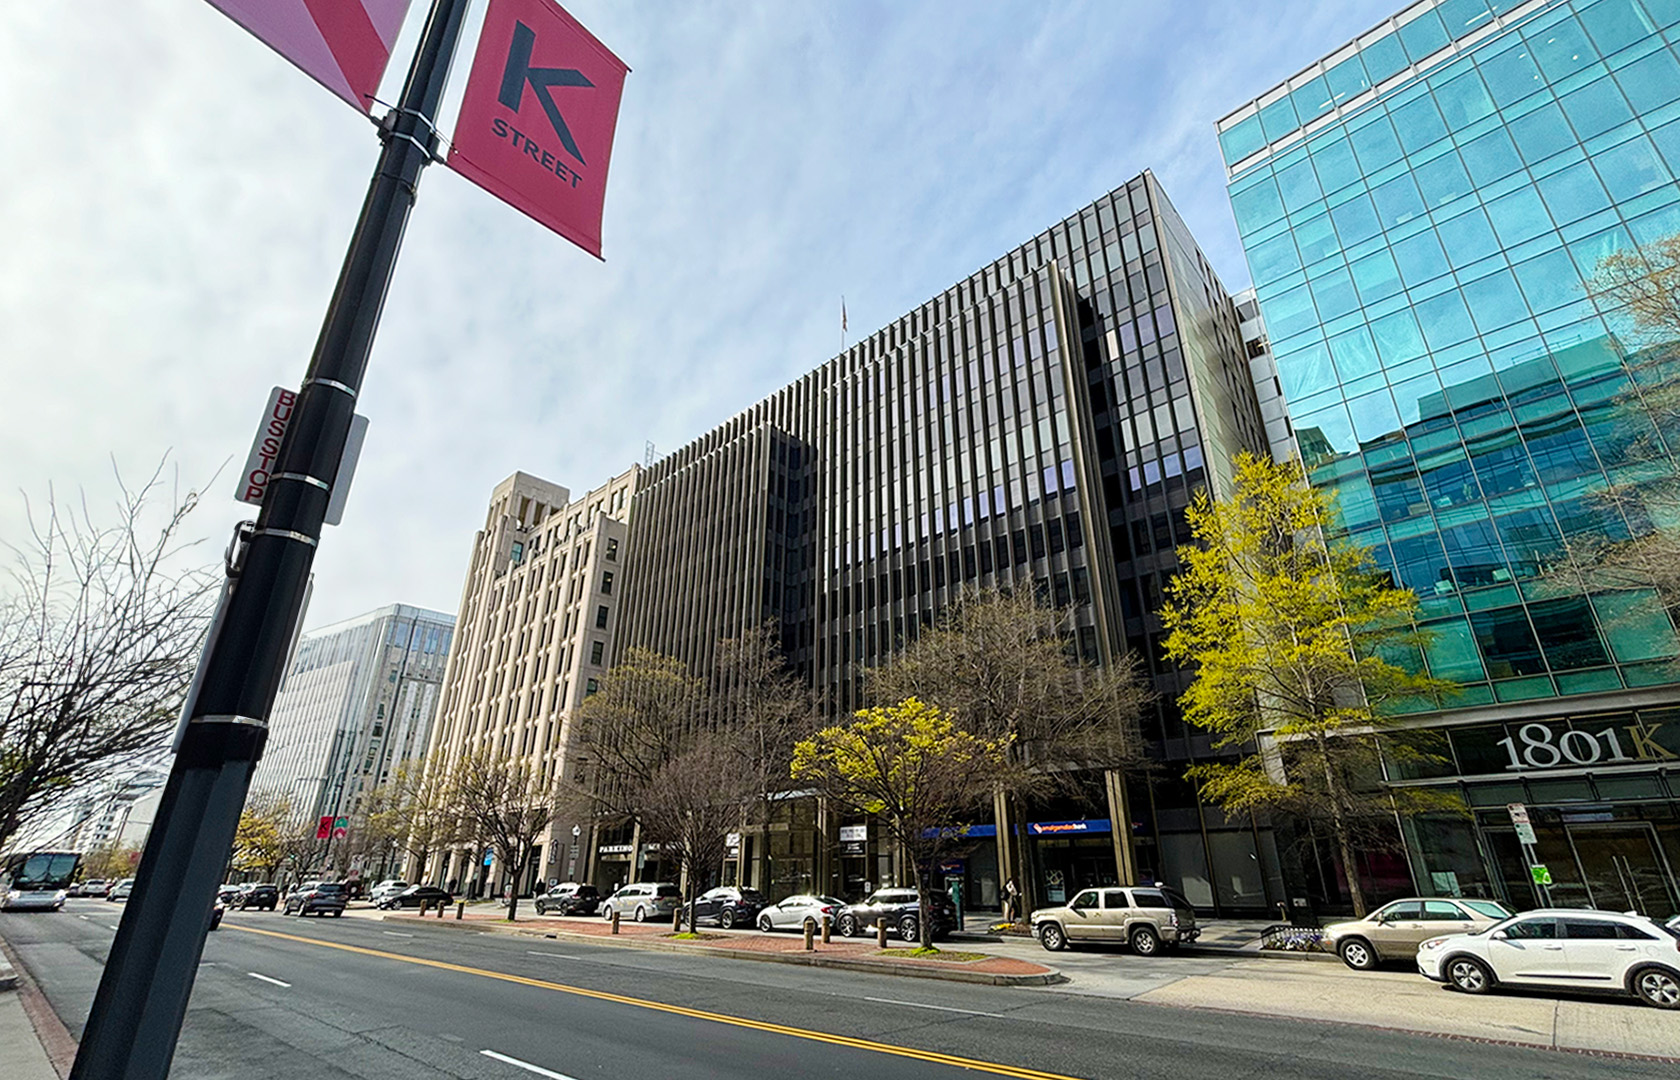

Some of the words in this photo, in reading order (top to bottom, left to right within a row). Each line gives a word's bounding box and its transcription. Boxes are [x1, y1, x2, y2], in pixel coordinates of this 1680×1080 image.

[498, 19, 597, 166] K
[491, 118, 583, 189] STREET
[267, 389, 297, 437] BUS
[244, 437, 280, 501] STOP
